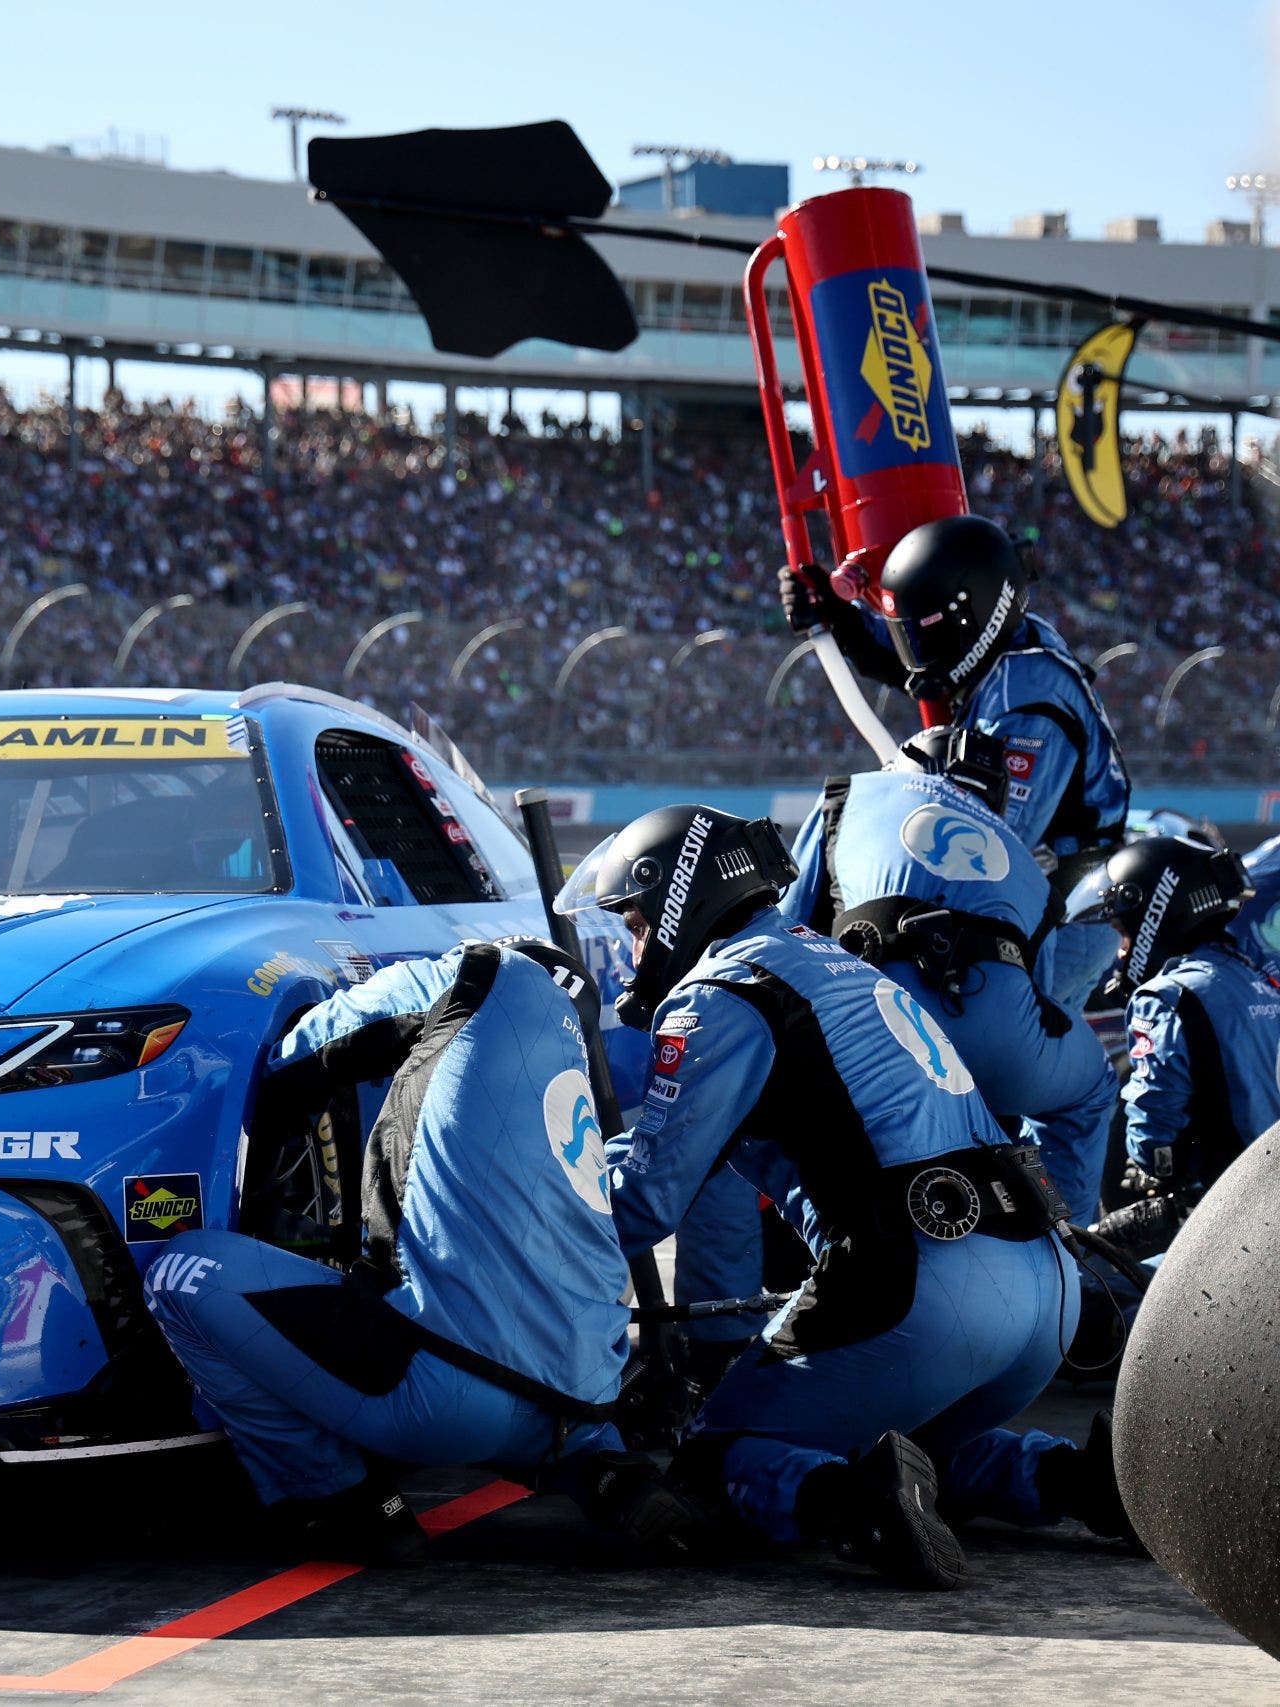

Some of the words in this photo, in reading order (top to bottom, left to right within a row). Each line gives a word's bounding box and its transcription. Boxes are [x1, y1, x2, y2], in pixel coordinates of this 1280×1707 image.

[872, 283, 930, 447] SUNOCO
[949, 578, 1016, 684] PROGRESSIVE
[656, 813, 713, 951] PROGRESSIVE
[1126, 866, 1181, 987] PROGRESSIVE
[553, 965, 586, 999] 11
[132, 1199, 196, 1220] SUNOCO
